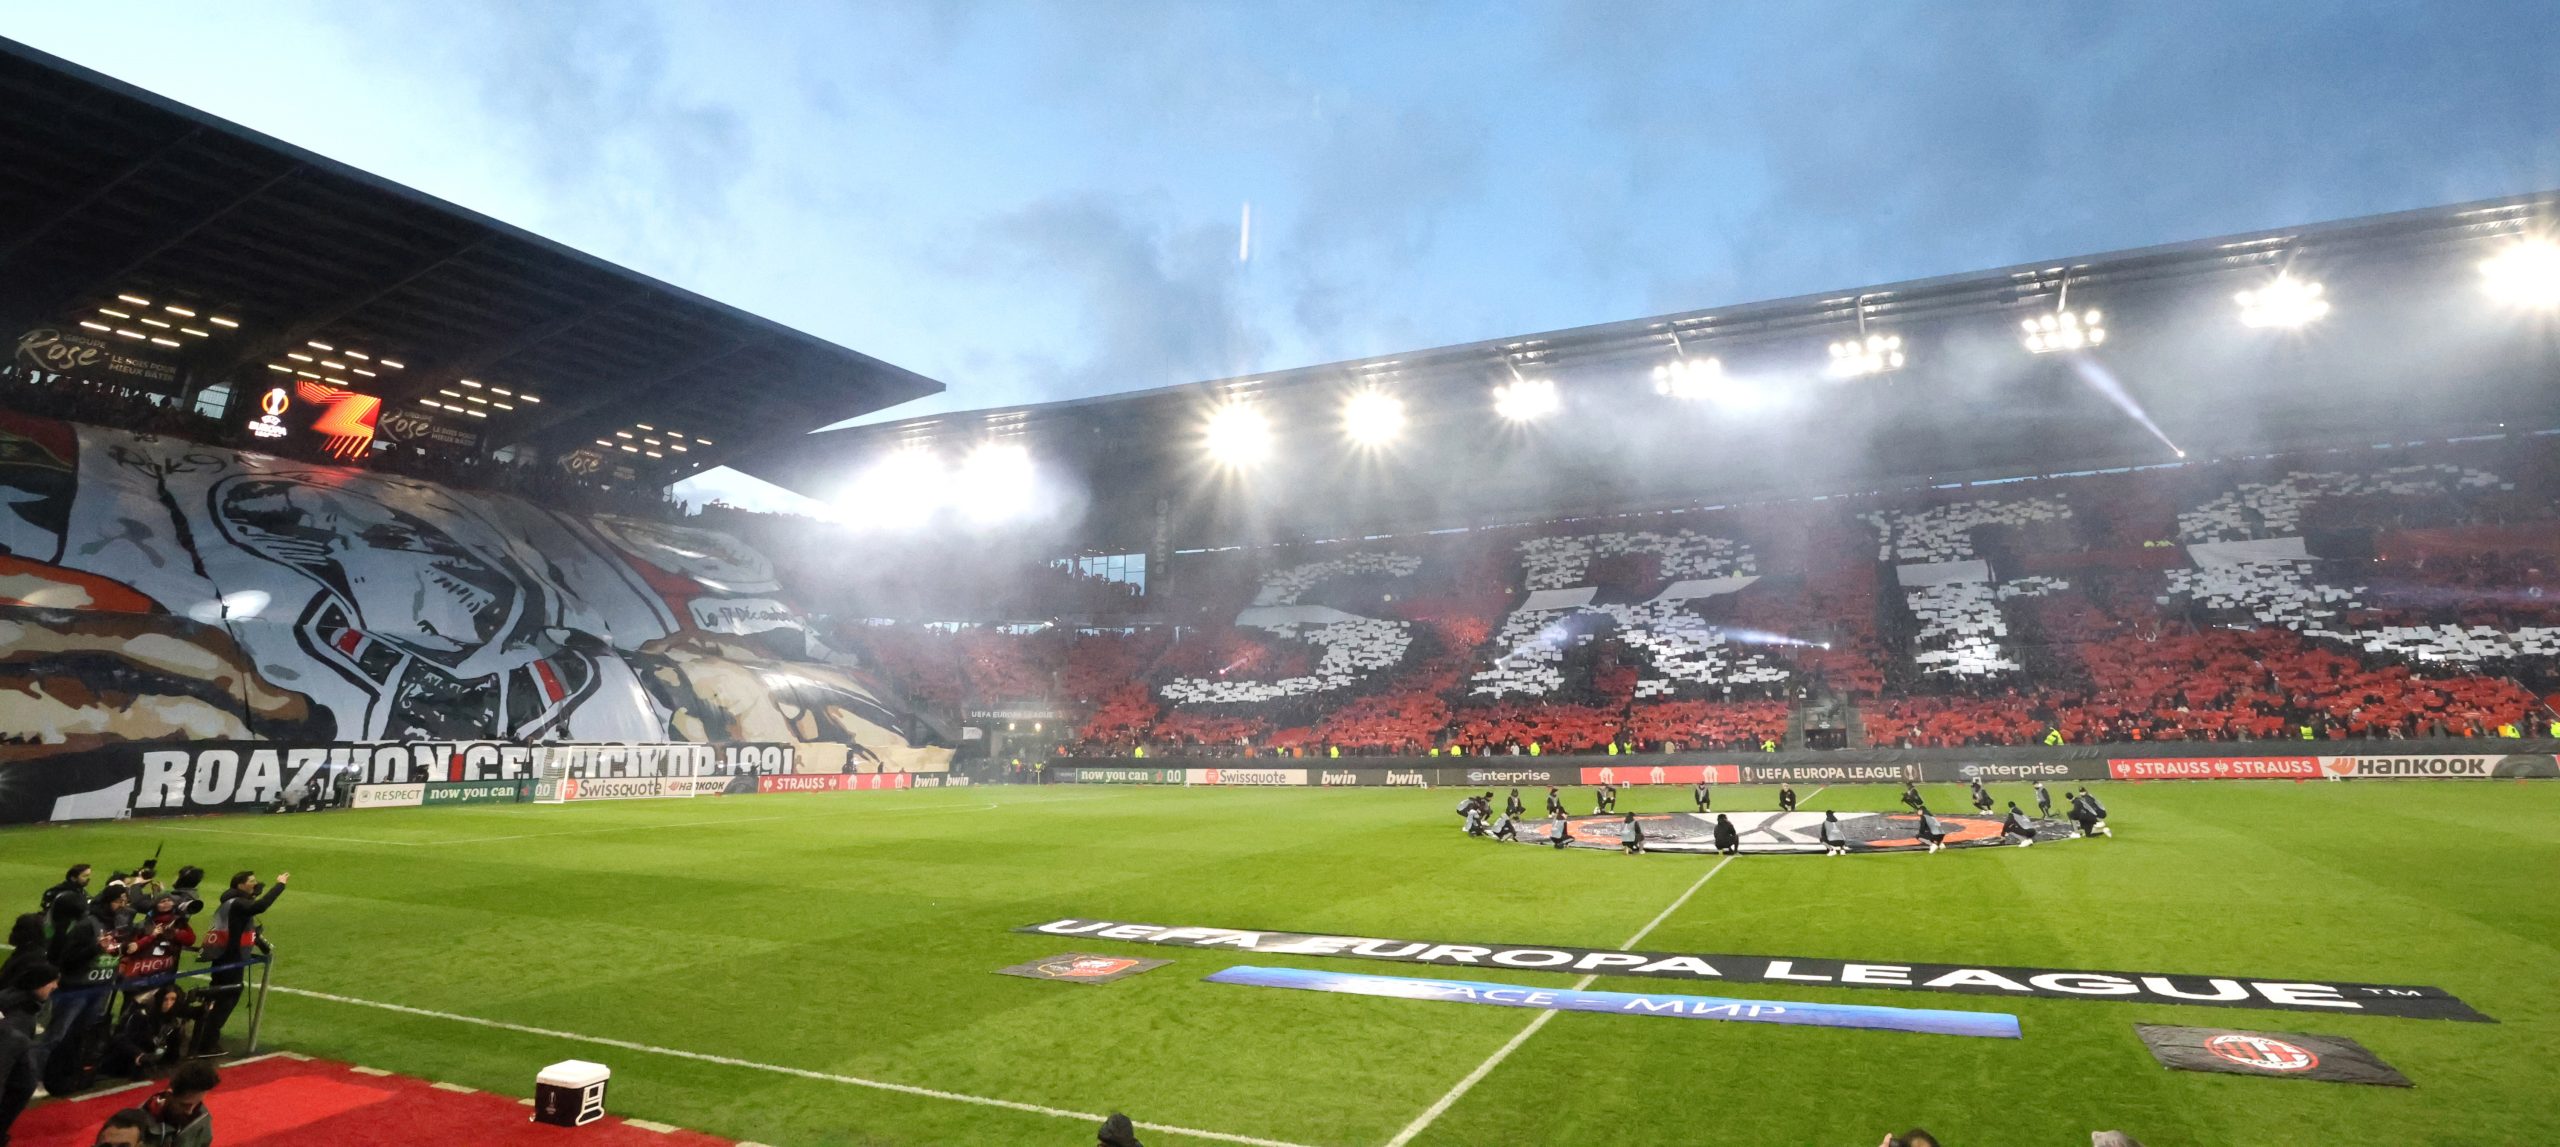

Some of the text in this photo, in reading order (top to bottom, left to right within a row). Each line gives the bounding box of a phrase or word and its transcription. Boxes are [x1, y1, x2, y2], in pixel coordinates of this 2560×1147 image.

[726, 745, 794, 775] 1991
[2135, 760, 2313, 775] STRAUSS STRAUSS
[1081, 770, 1104, 781] now
[1105, 771, 1127, 783] you
[1128, 770, 1149, 781] can
[1220, 770, 1287, 785] Swissquote
[1320, 770, 1356, 785] bwin
[1386, 770, 1423, 785] bwin
[1467, 769, 1551, 783] enterprise
[1755, 766, 1902, 780] UEFA EUROPA LEAGUE
[1960, 762, 2069, 778] enterprise
[776, 777, 825, 790] STRAUSS
[914, 774, 939, 788] bwin
[945, 773, 969, 786] bwin
[374, 789, 422, 801] RESPECT
[430, 788, 460, 800] now
[462, 787, 488, 801] you
[490, 786, 515, 798] can
[580, 780, 662, 798] Swissquote
[1037, 919, 1261, 948] UEFA
[1290, 935, 1723, 977] EUROPA
[1764, 960, 2363, 1009] LEAGUE
